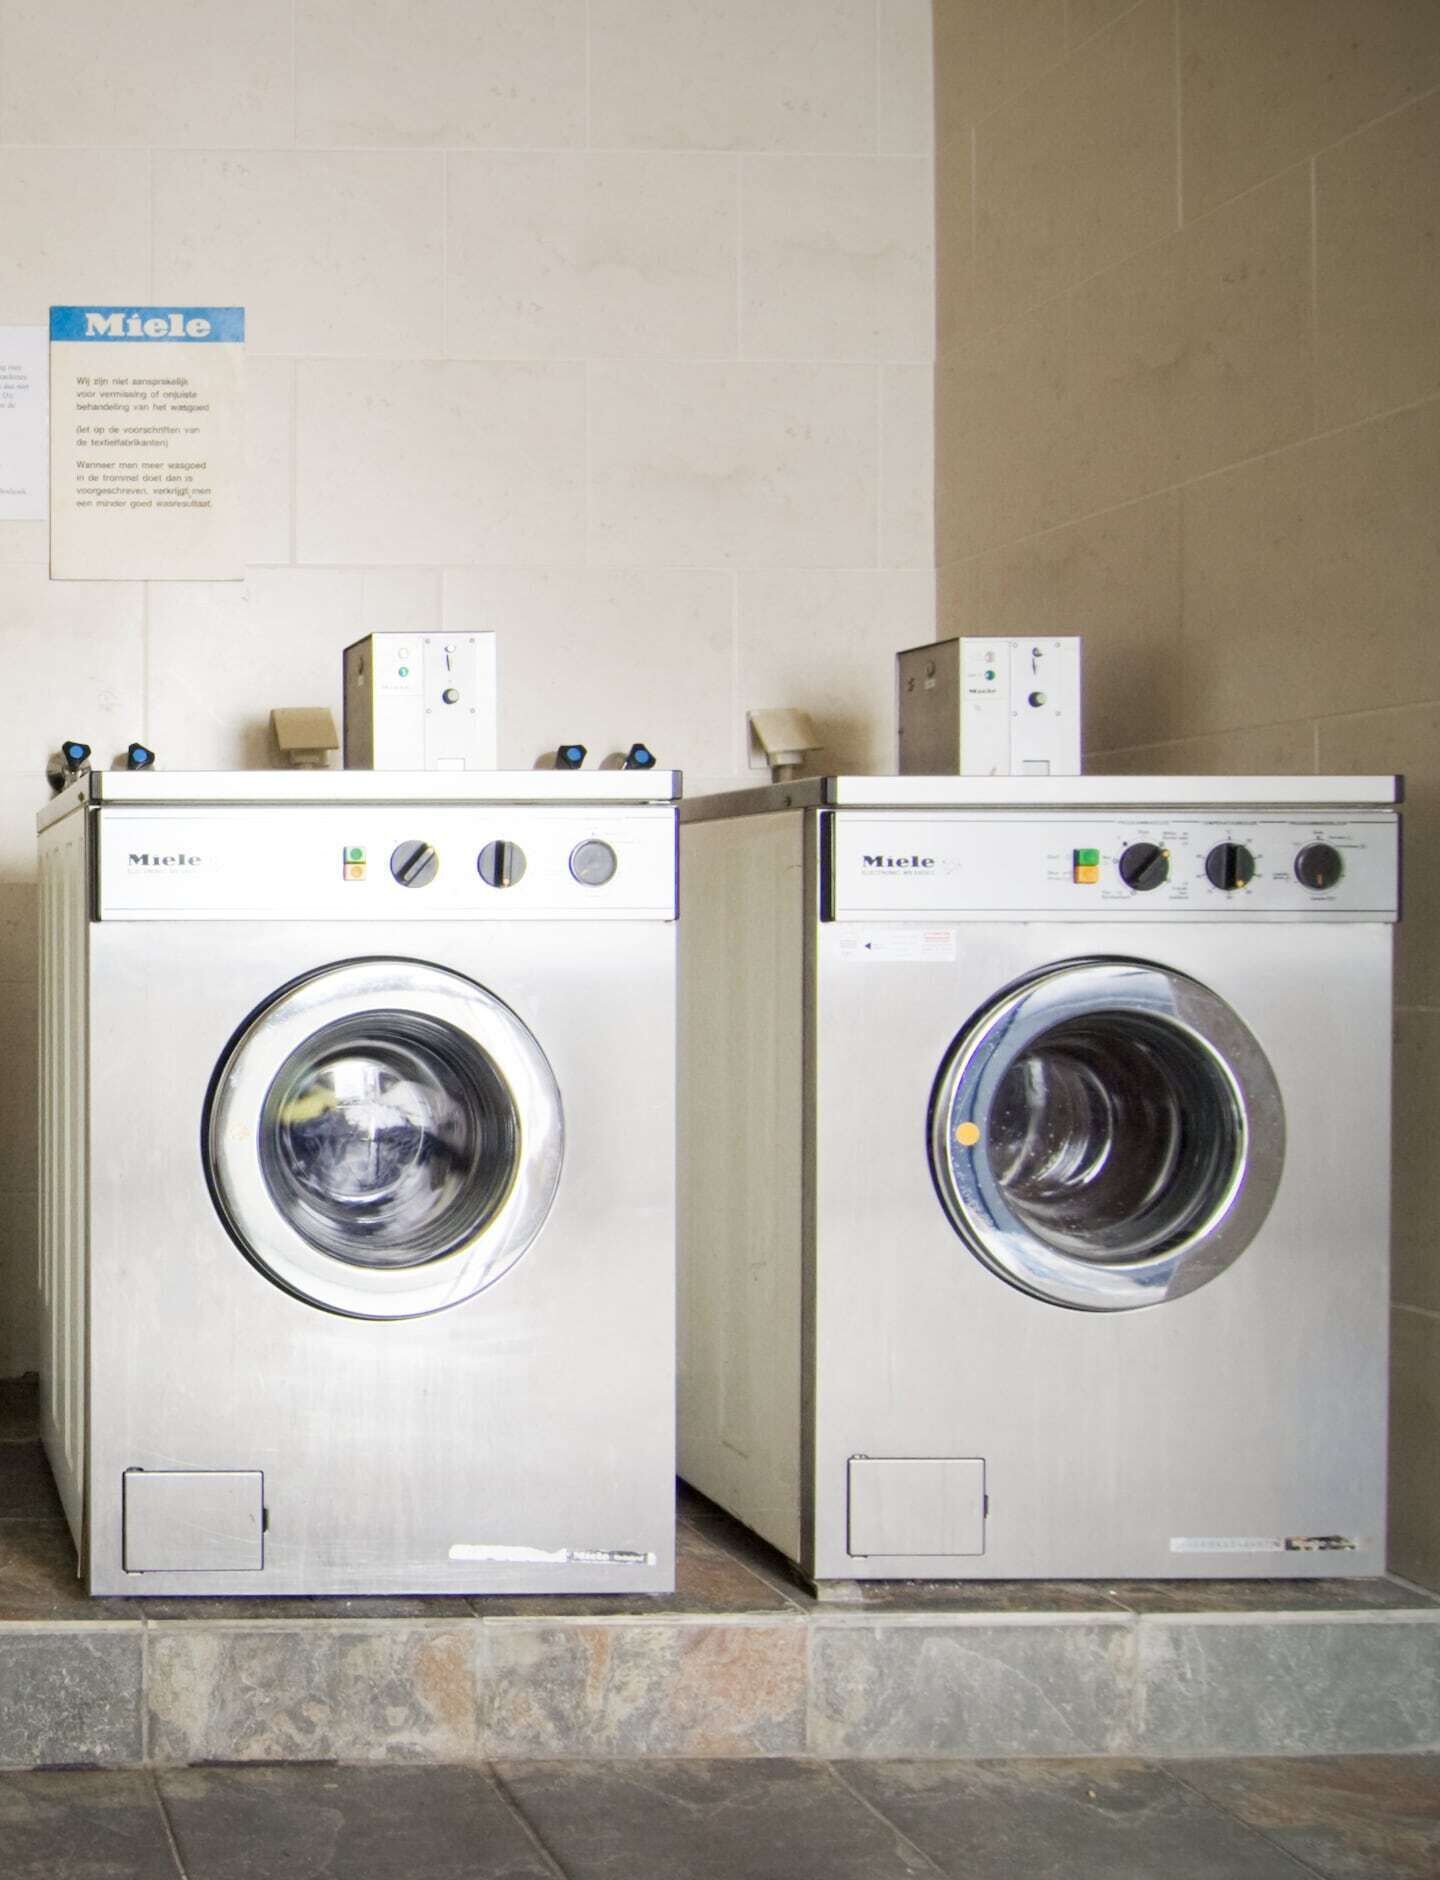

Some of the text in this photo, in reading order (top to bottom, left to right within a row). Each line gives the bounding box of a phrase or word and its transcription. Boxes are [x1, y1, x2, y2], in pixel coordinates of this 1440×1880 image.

[84, 311, 211, 338] Miele
[76, 377, 90, 386] Wij
[94, 377, 109, 386] zijn
[112, 377, 128, 385] niet
[100, 391, 147, 400] vermissing
[76, 403, 130, 412] behandeling
[153, 403, 167, 411] het
[123, 426, 181, 434] voorschriften
[76, 461, 116, 469] Wanneer
[168, 461, 207, 470] wasgoed
[128, 853, 202, 866] Miele
[862, 855, 935, 868] Miele
